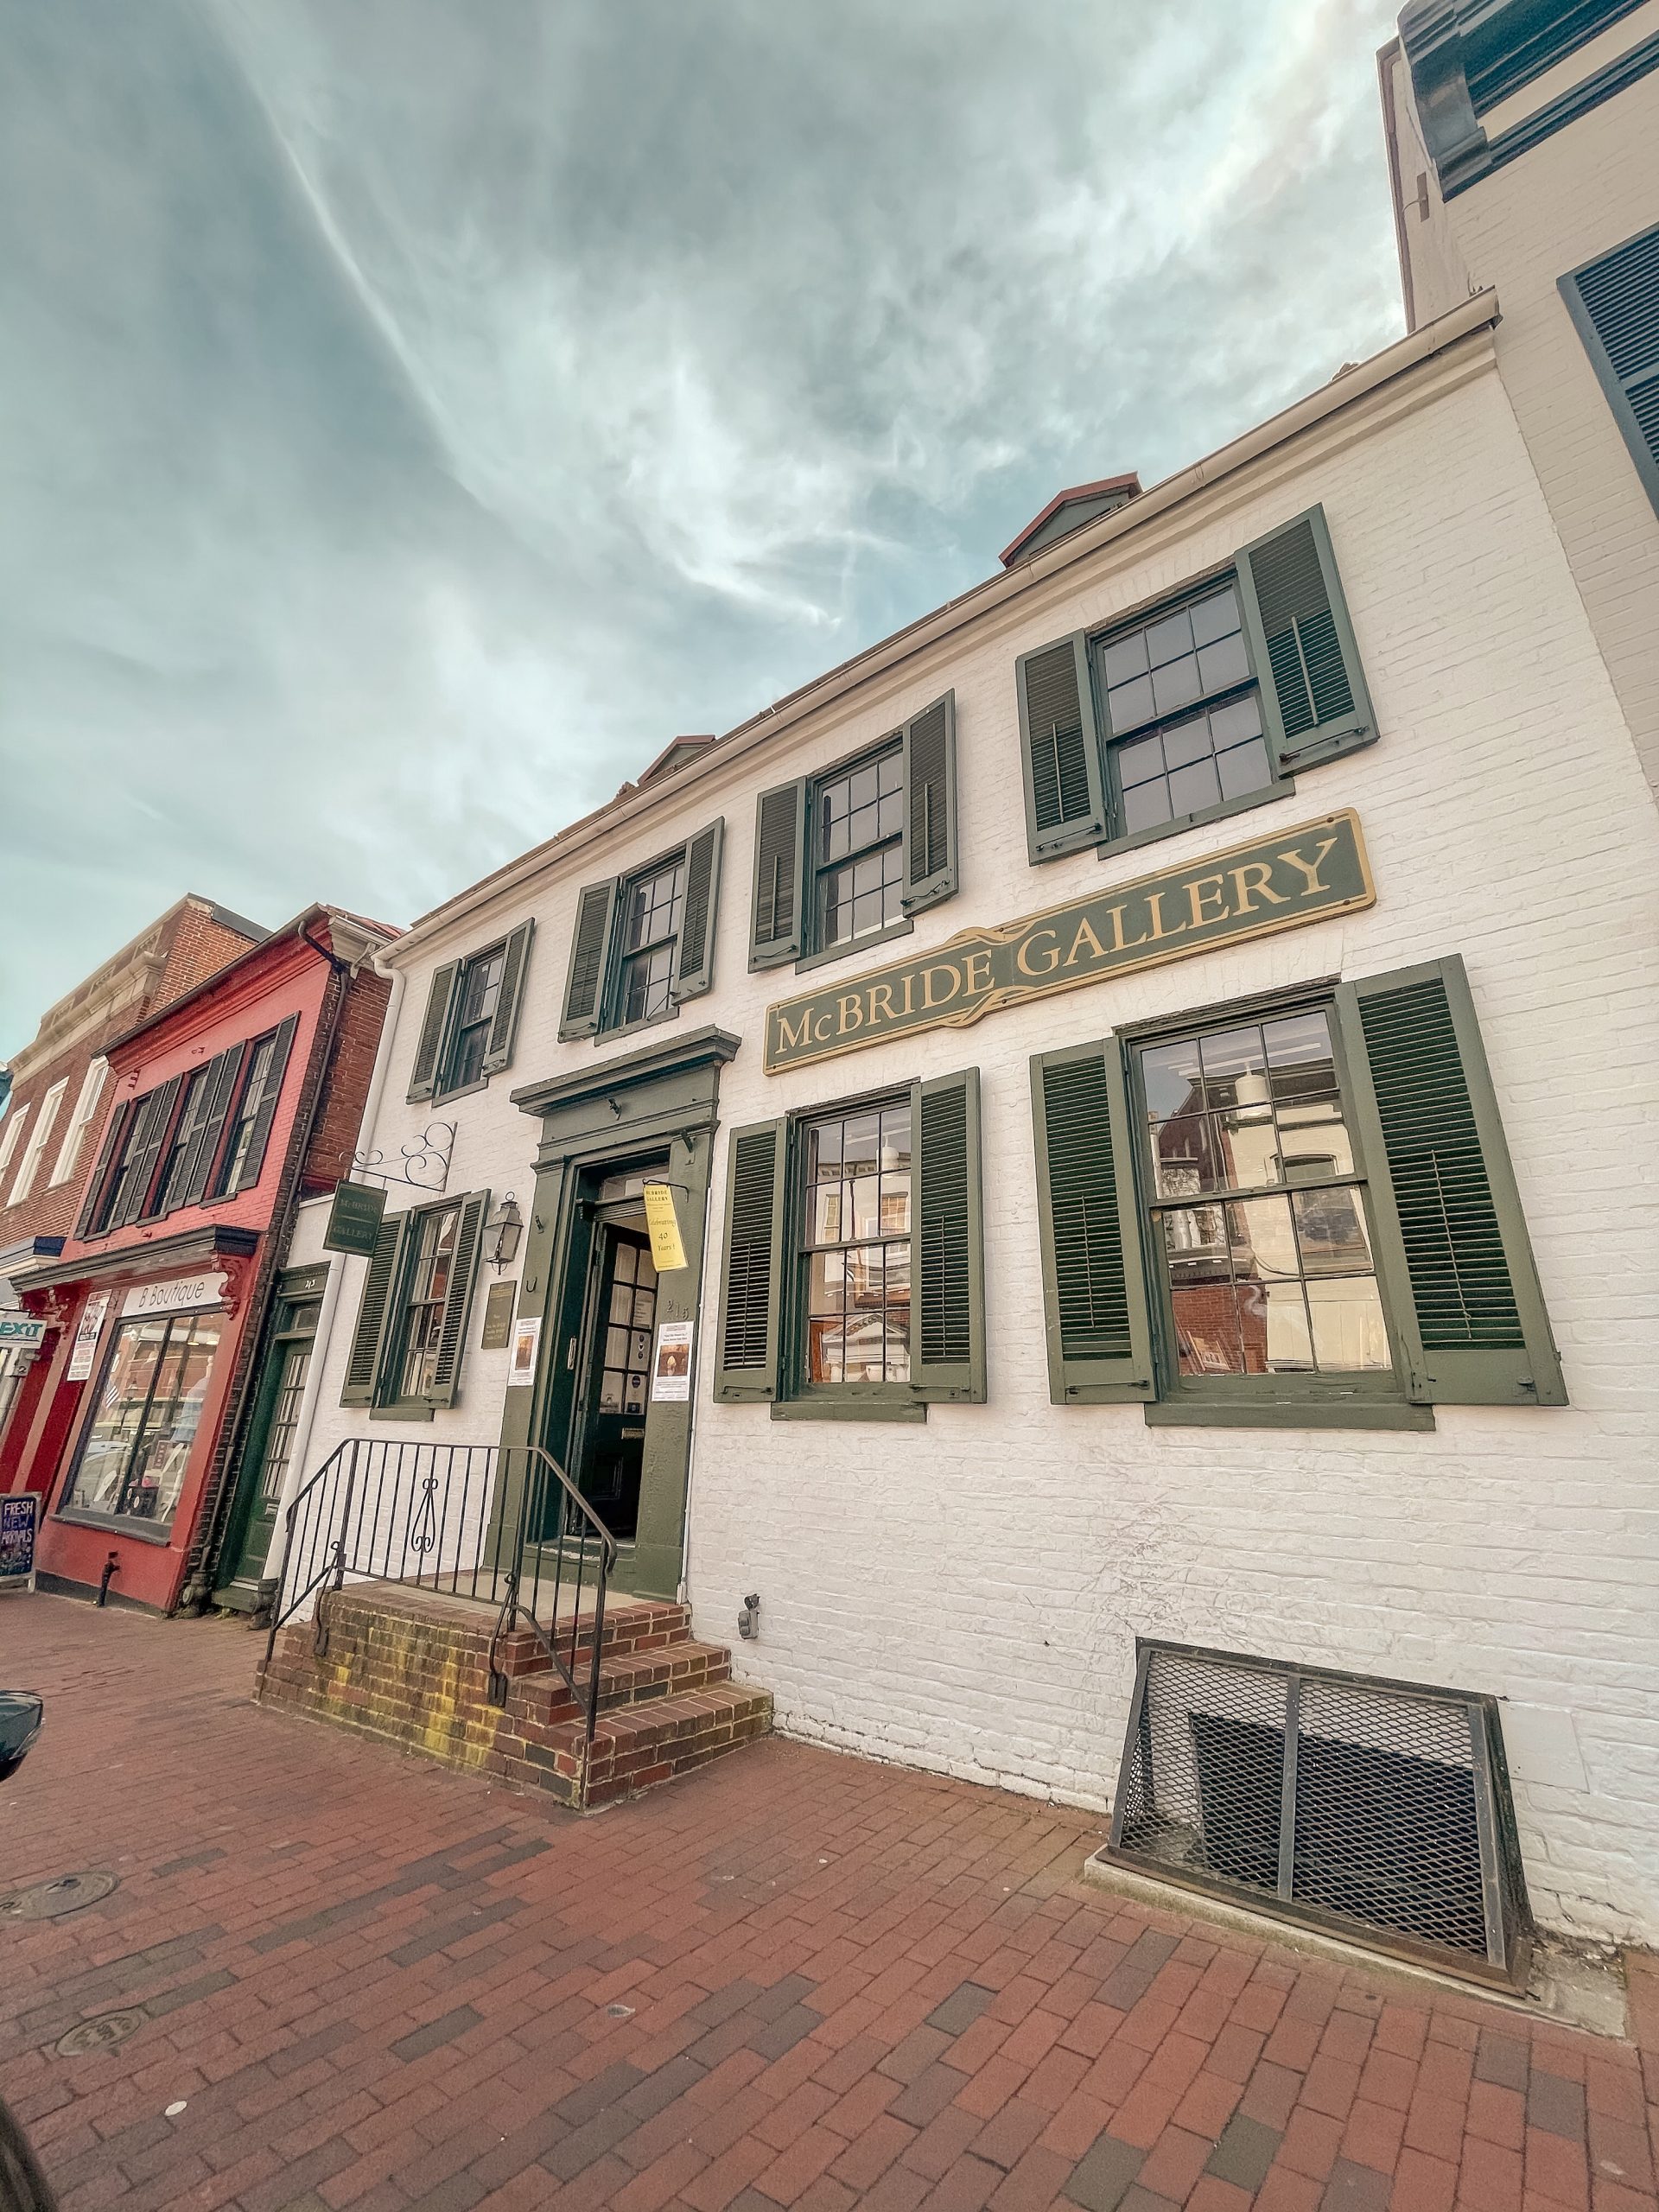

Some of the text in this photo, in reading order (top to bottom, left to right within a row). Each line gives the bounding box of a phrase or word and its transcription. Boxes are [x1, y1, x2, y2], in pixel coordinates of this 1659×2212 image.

[774, 837, 1338, 1054] McBRIDE GALLERY
[334, 1226, 372, 1240] GALLERY
[138, 1287, 149, 1308] B
[149, 1281, 205, 1306] Boutique
[666, 1299, 690, 1320] 215
[4, 1501, 34, 1516] FRESH
[3, 1515, 29, 1529] NEW
